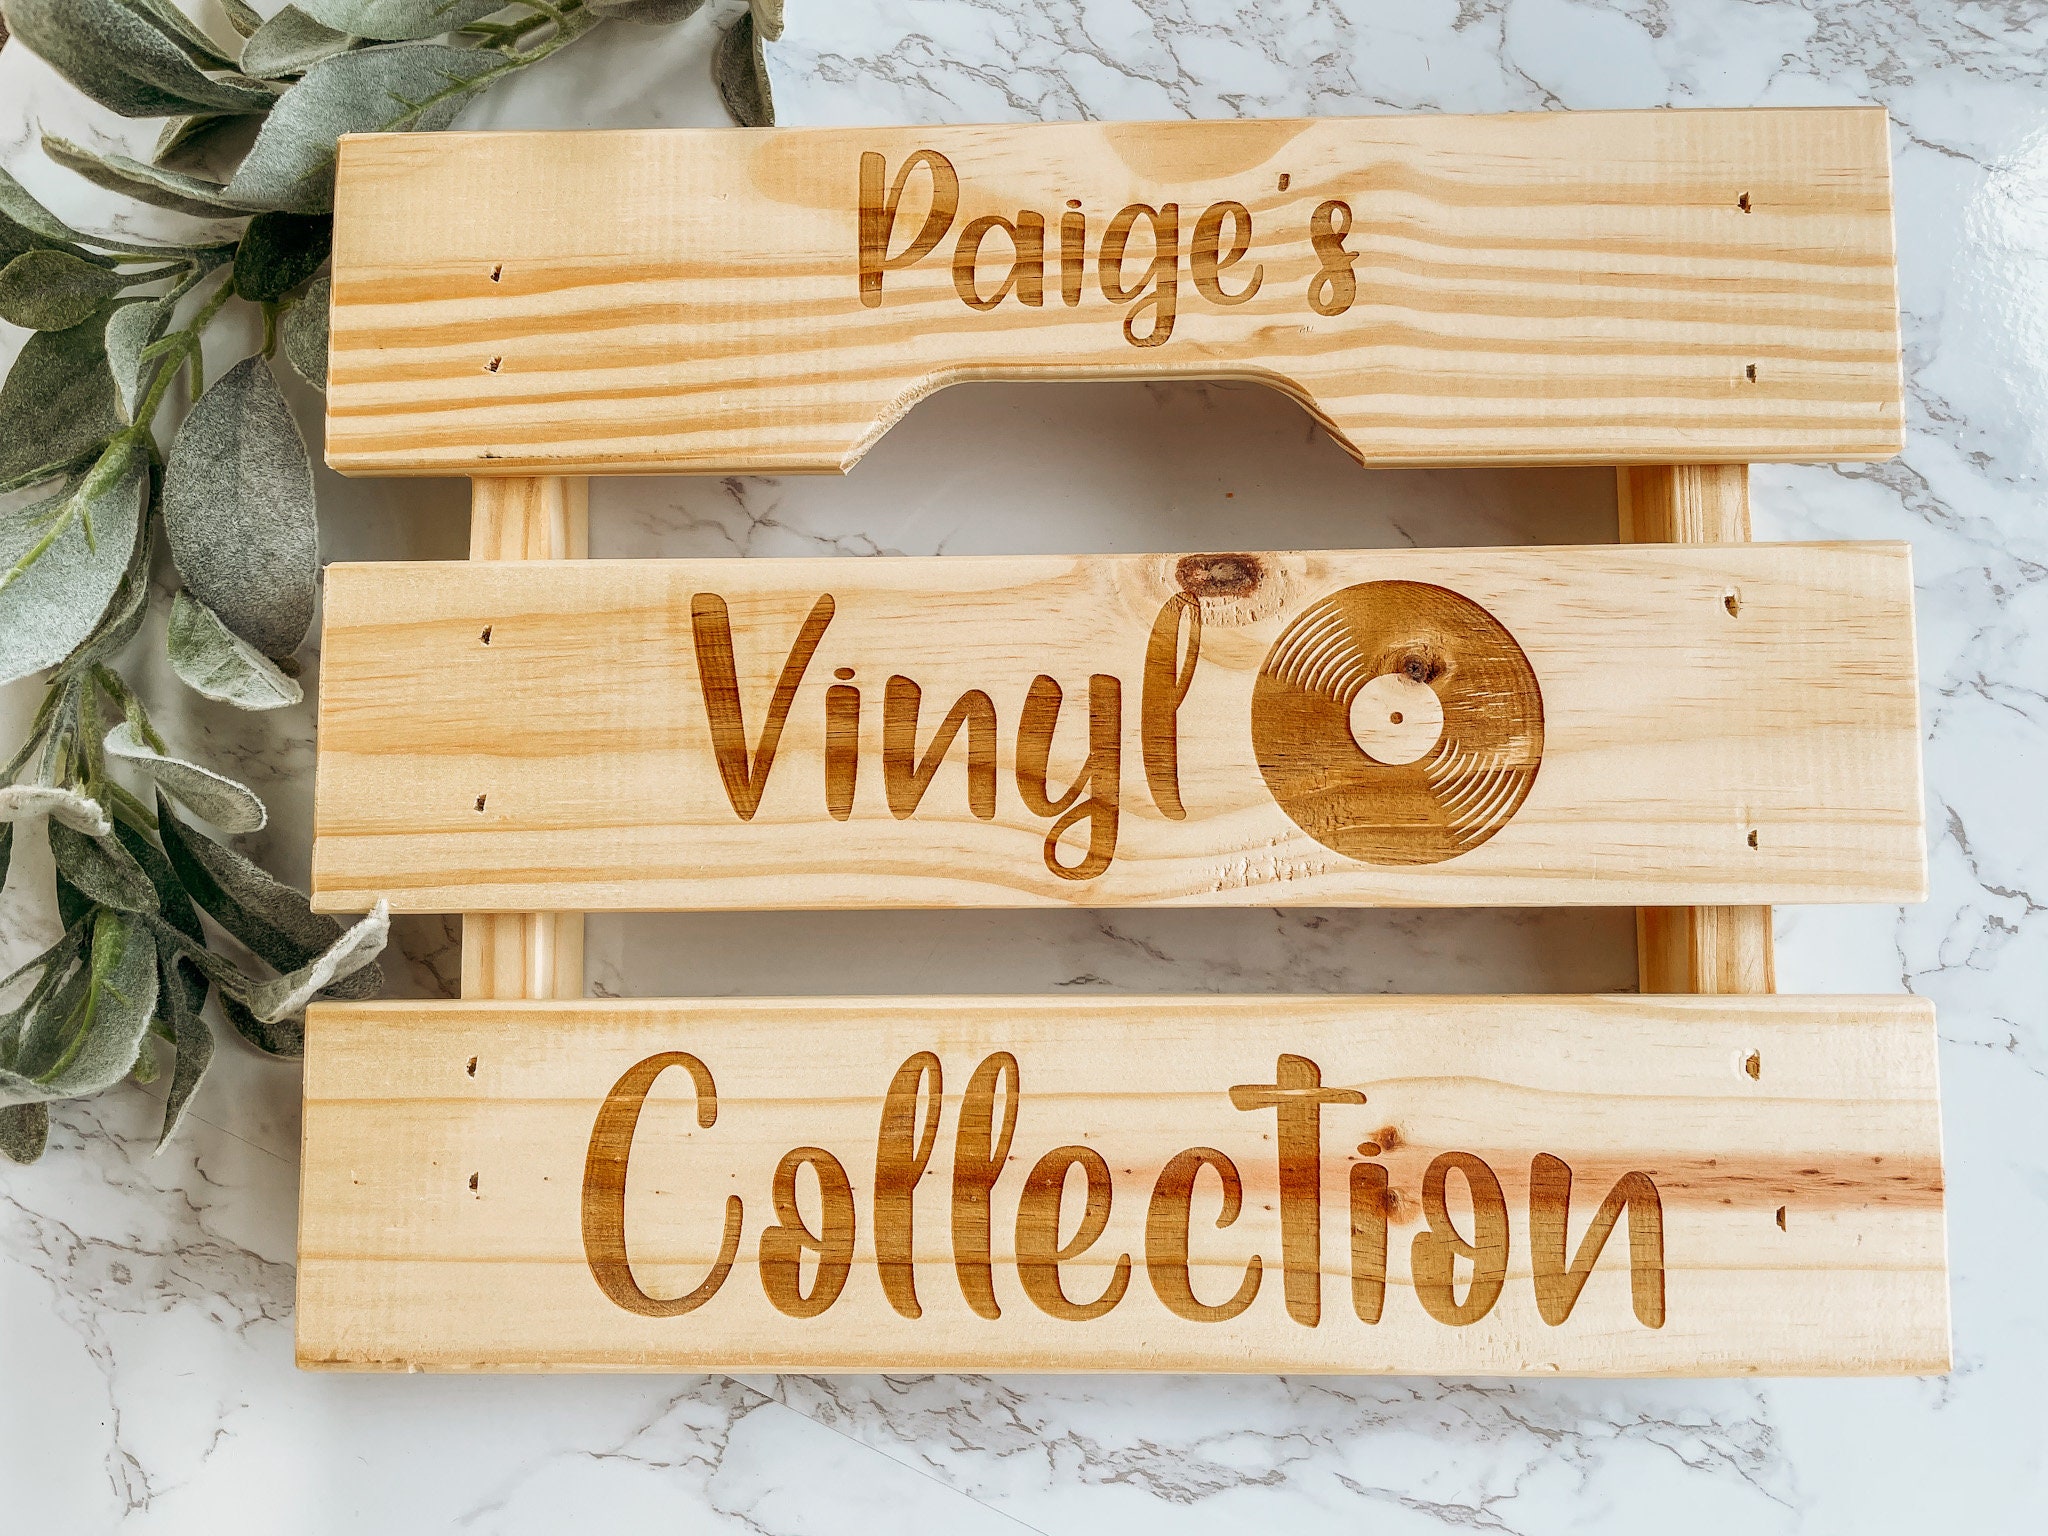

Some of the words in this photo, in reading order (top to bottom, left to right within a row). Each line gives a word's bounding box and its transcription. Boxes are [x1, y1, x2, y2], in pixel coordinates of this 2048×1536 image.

[858, 148, 1360, 348] Paige's
[690, 591, 1202, 881] Vinyl
[581, 1050, 1666, 1330] Collection
